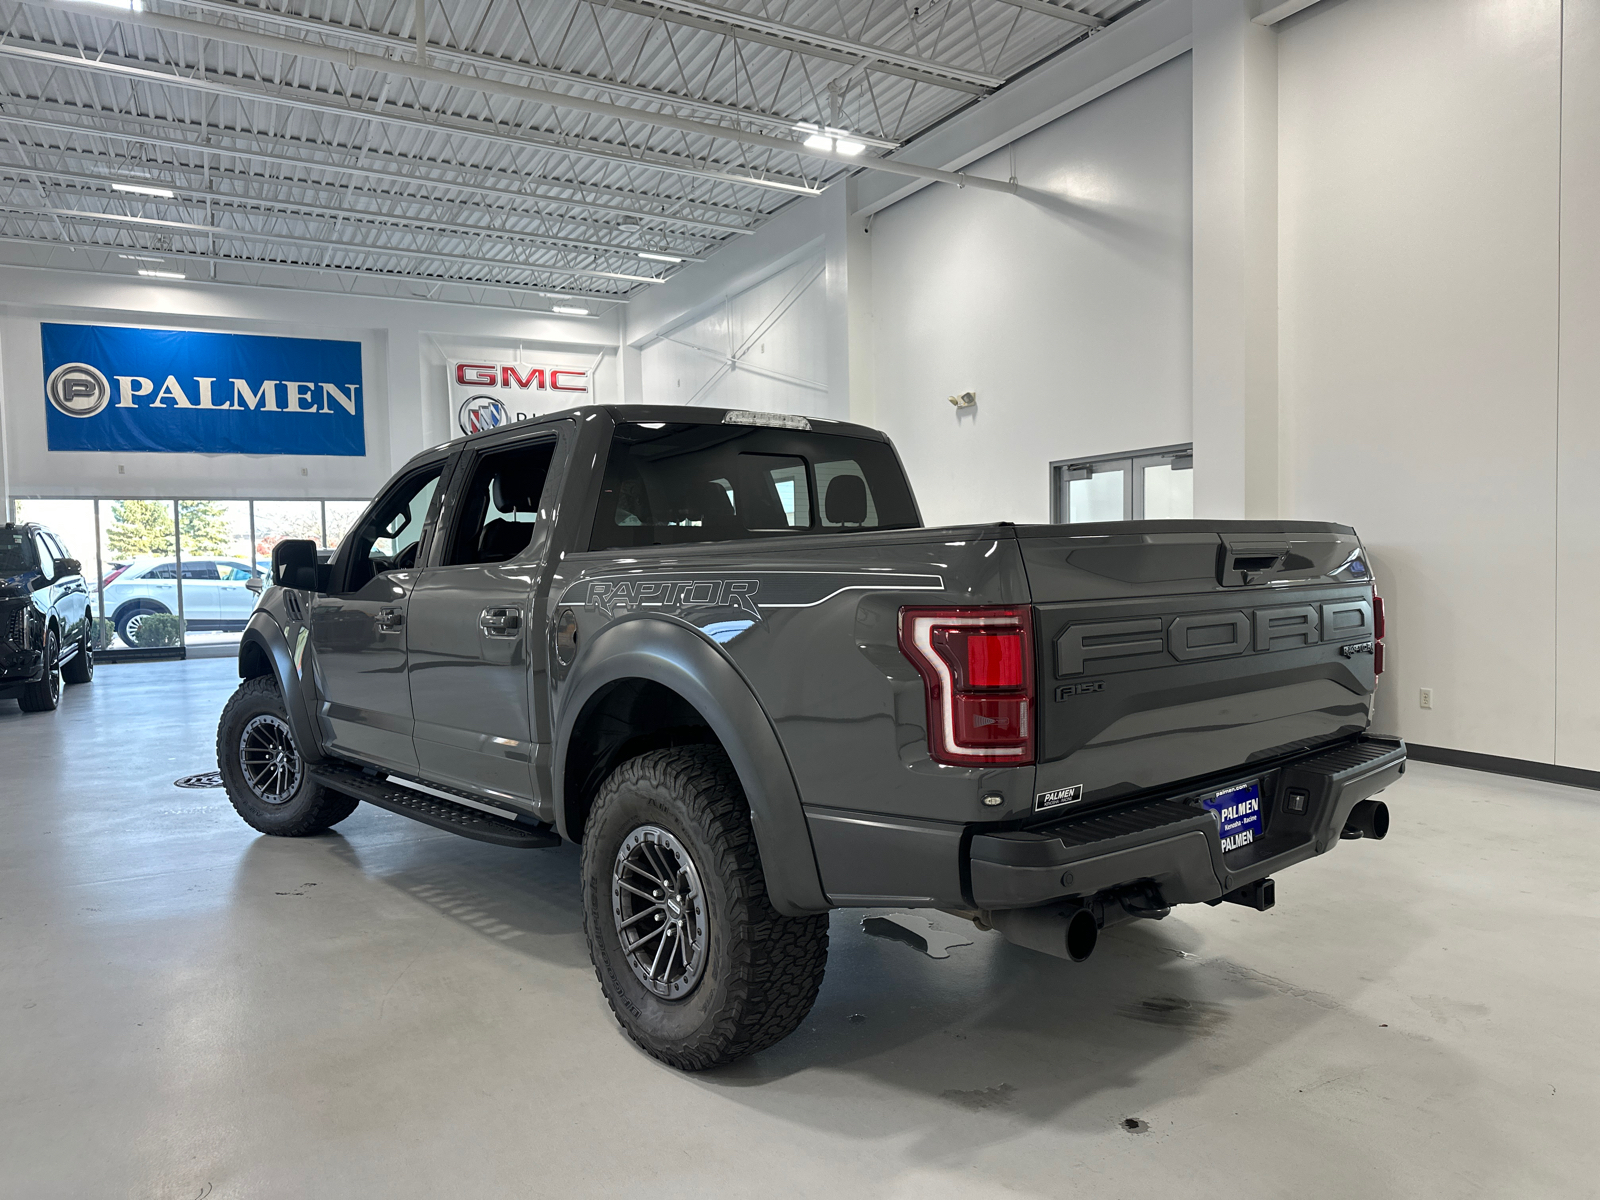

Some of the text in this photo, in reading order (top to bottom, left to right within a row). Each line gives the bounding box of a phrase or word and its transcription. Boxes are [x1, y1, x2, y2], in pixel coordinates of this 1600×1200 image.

[455, 362, 588, 393] GMC
[113, 375, 360, 416] PALMEN
[585, 579, 764, 622] RAPTOR
[1053, 599, 1373, 680] FORD
[1044, 788, 1075, 802] PALMEN
[1216, 784, 1247, 797] palmen.com
[1221, 798, 1258, 822] PALMEN
[1225, 815, 1257, 831] Kenosha Racine
[1221, 829, 1253, 853] PALMEN
